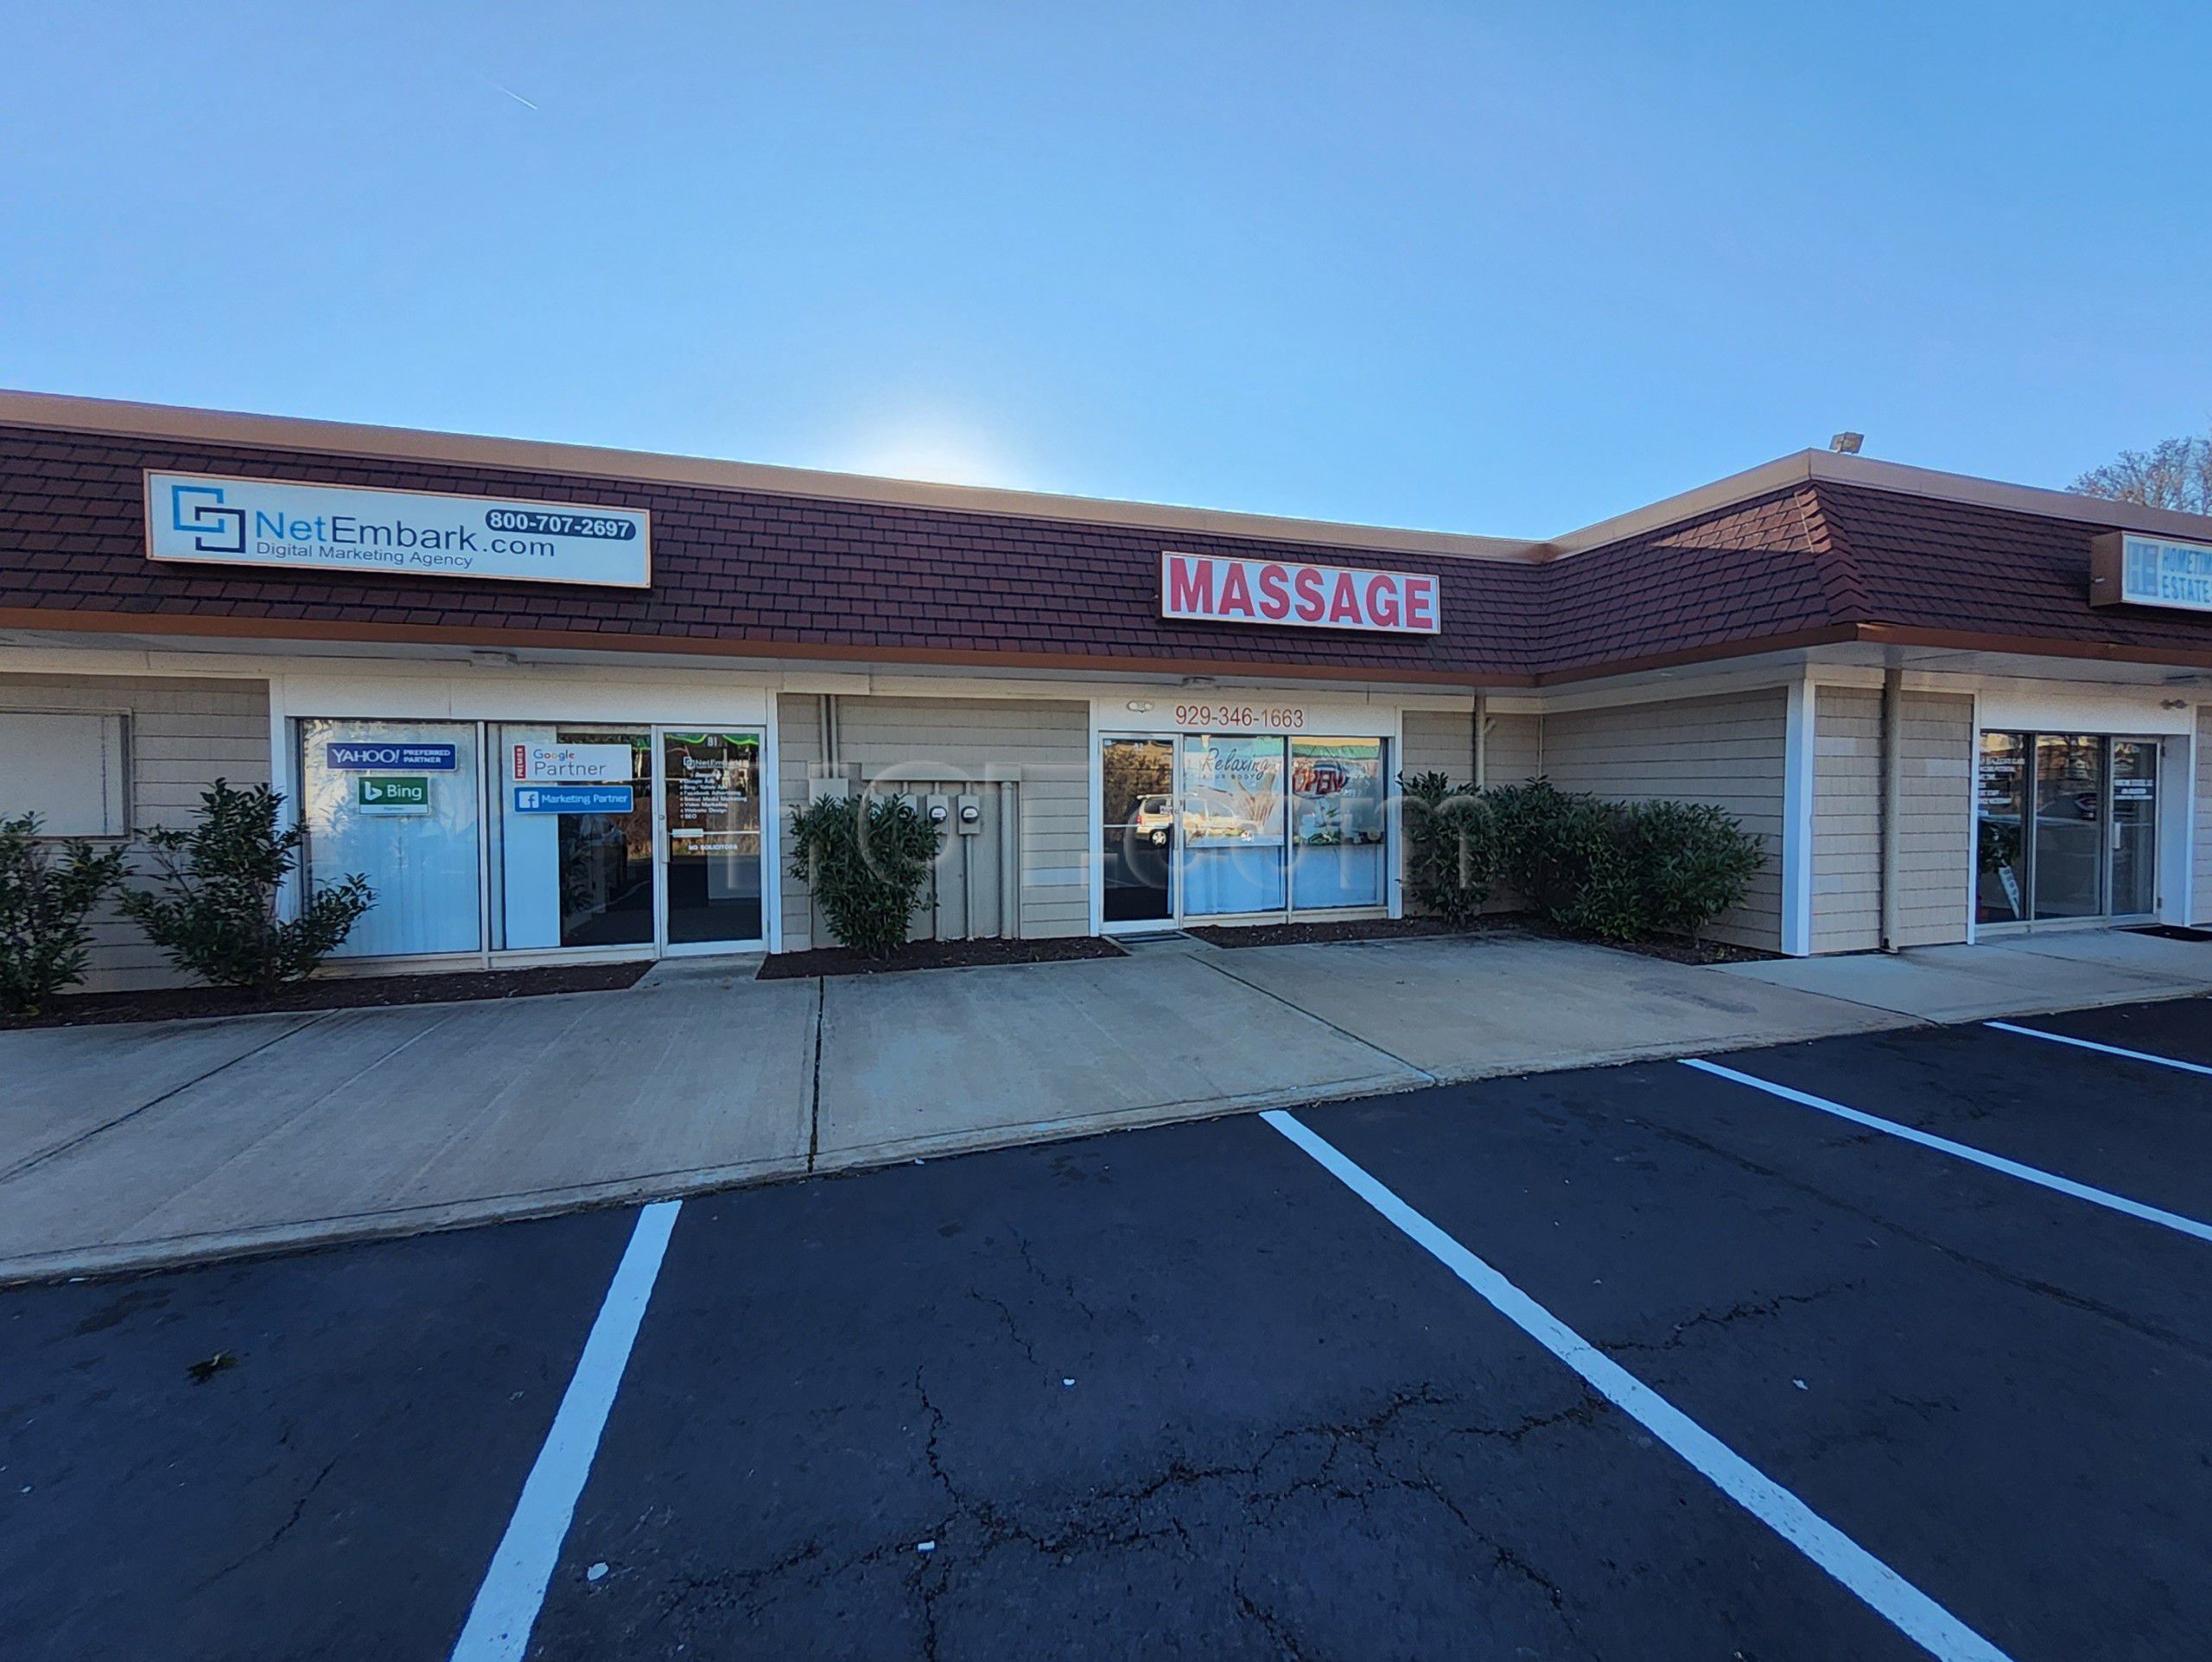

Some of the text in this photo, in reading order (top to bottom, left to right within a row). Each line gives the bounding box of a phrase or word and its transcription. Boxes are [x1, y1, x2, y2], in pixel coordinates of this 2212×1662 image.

[256, 510, 555, 557] NetEmbark.com
[490, 511, 631, 538] 800-707-2697
[257, 541, 474, 569] Digital Marketing Agency
[1168, 557, 1433, 630] MASSAGE
[2162, 574, 2212, 603] ESTATE
[1175, 704, 1305, 728] 929-346-1663
[331, 748, 400, 764] YAHOO!
[532, 748, 575, 761] Google
[1200, 747, 1270, 781] Relaxing
[534, 761, 607, 776] Partner
[1293, 766, 1346, 795] OPEN
[386, 784, 423, 801] Bing
[541, 794, 628, 805] Marketing Partner
